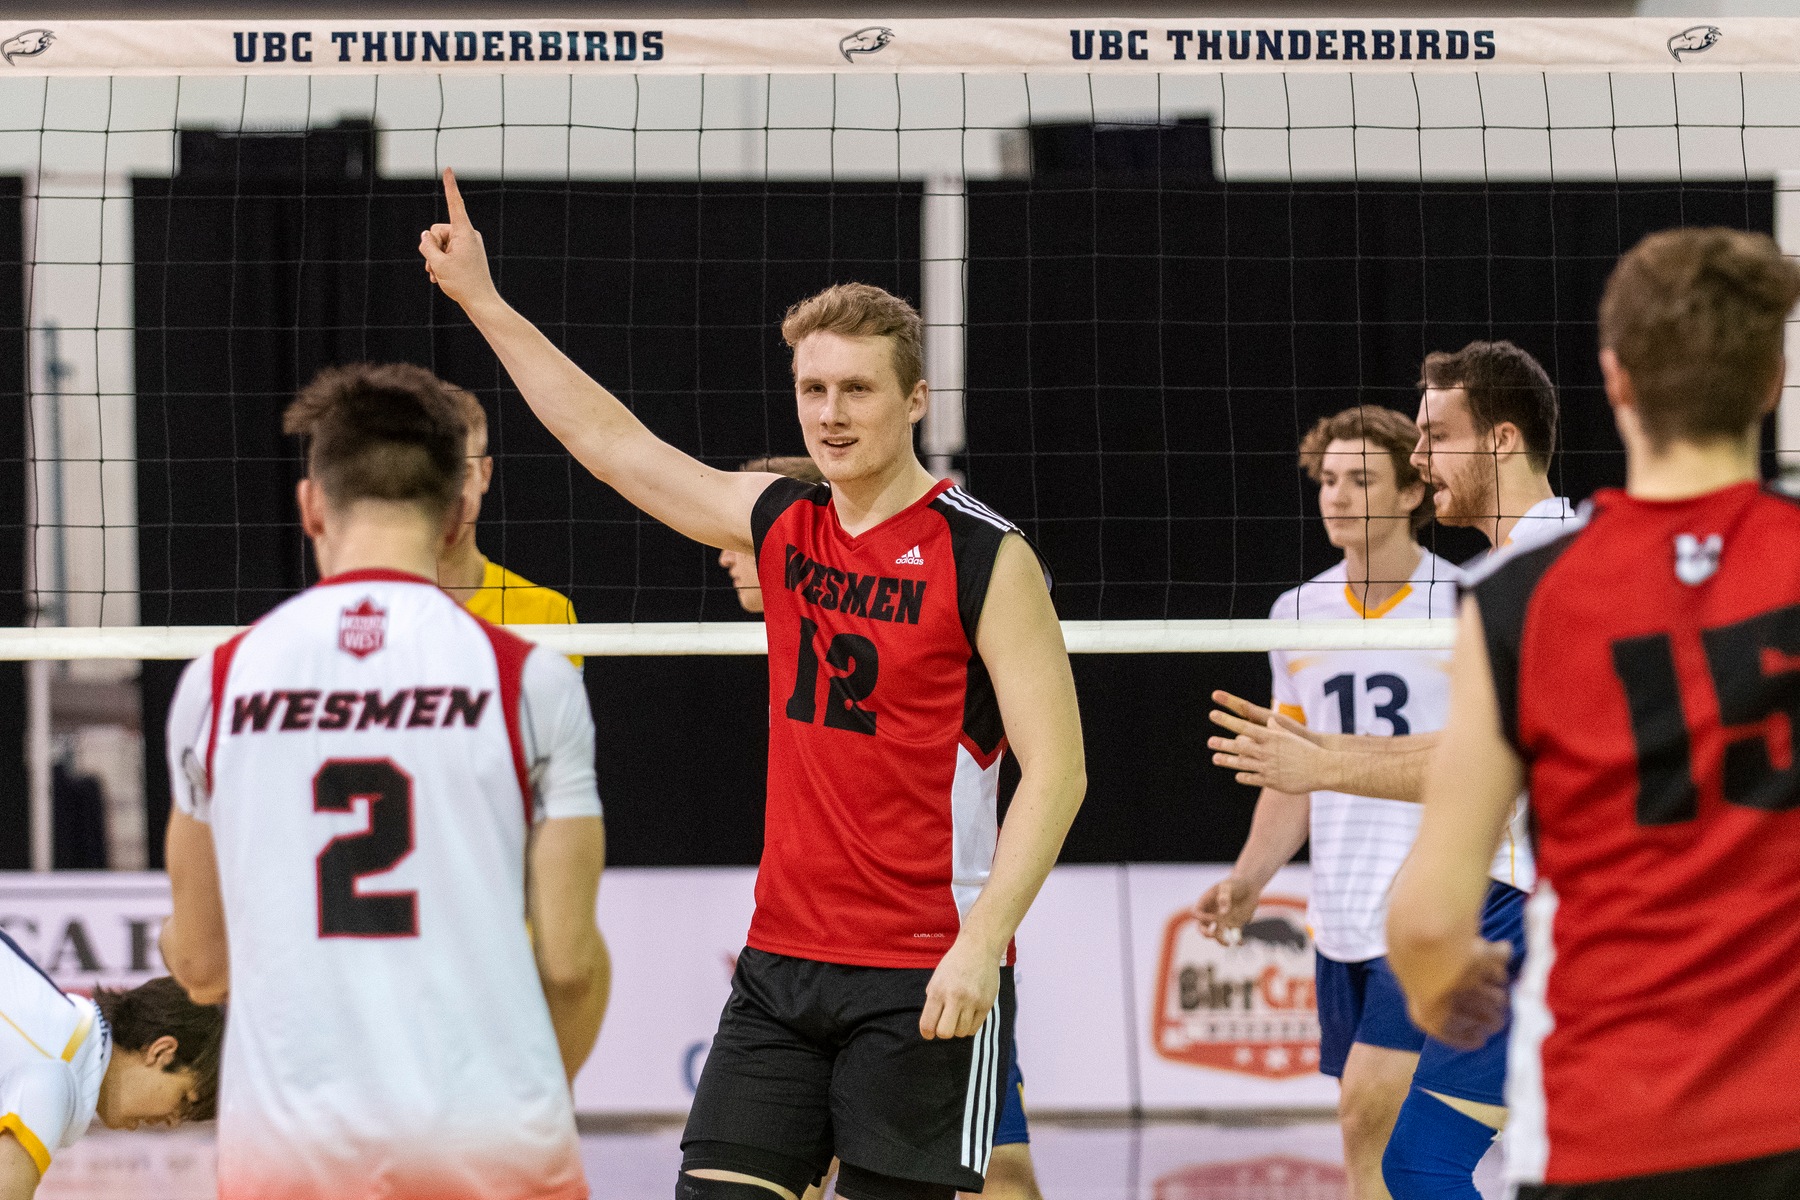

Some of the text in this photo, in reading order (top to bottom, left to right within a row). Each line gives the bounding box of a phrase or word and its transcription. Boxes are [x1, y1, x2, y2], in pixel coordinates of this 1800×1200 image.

[233, 31, 665, 63] UBC THUNDERBIRDS
[1070, 29, 1497, 60] UBC THUNDERBIRDS
[785, 543, 927, 625] WESMEN
[895, 557, 925, 566] adidas
[785, 615, 879, 736] 12
[1323, 672, 1410, 736] 13
[231, 687, 493, 736] WESMEN
[1610, 603, 1800, 826] 15
[312, 757, 420, 940] 2
